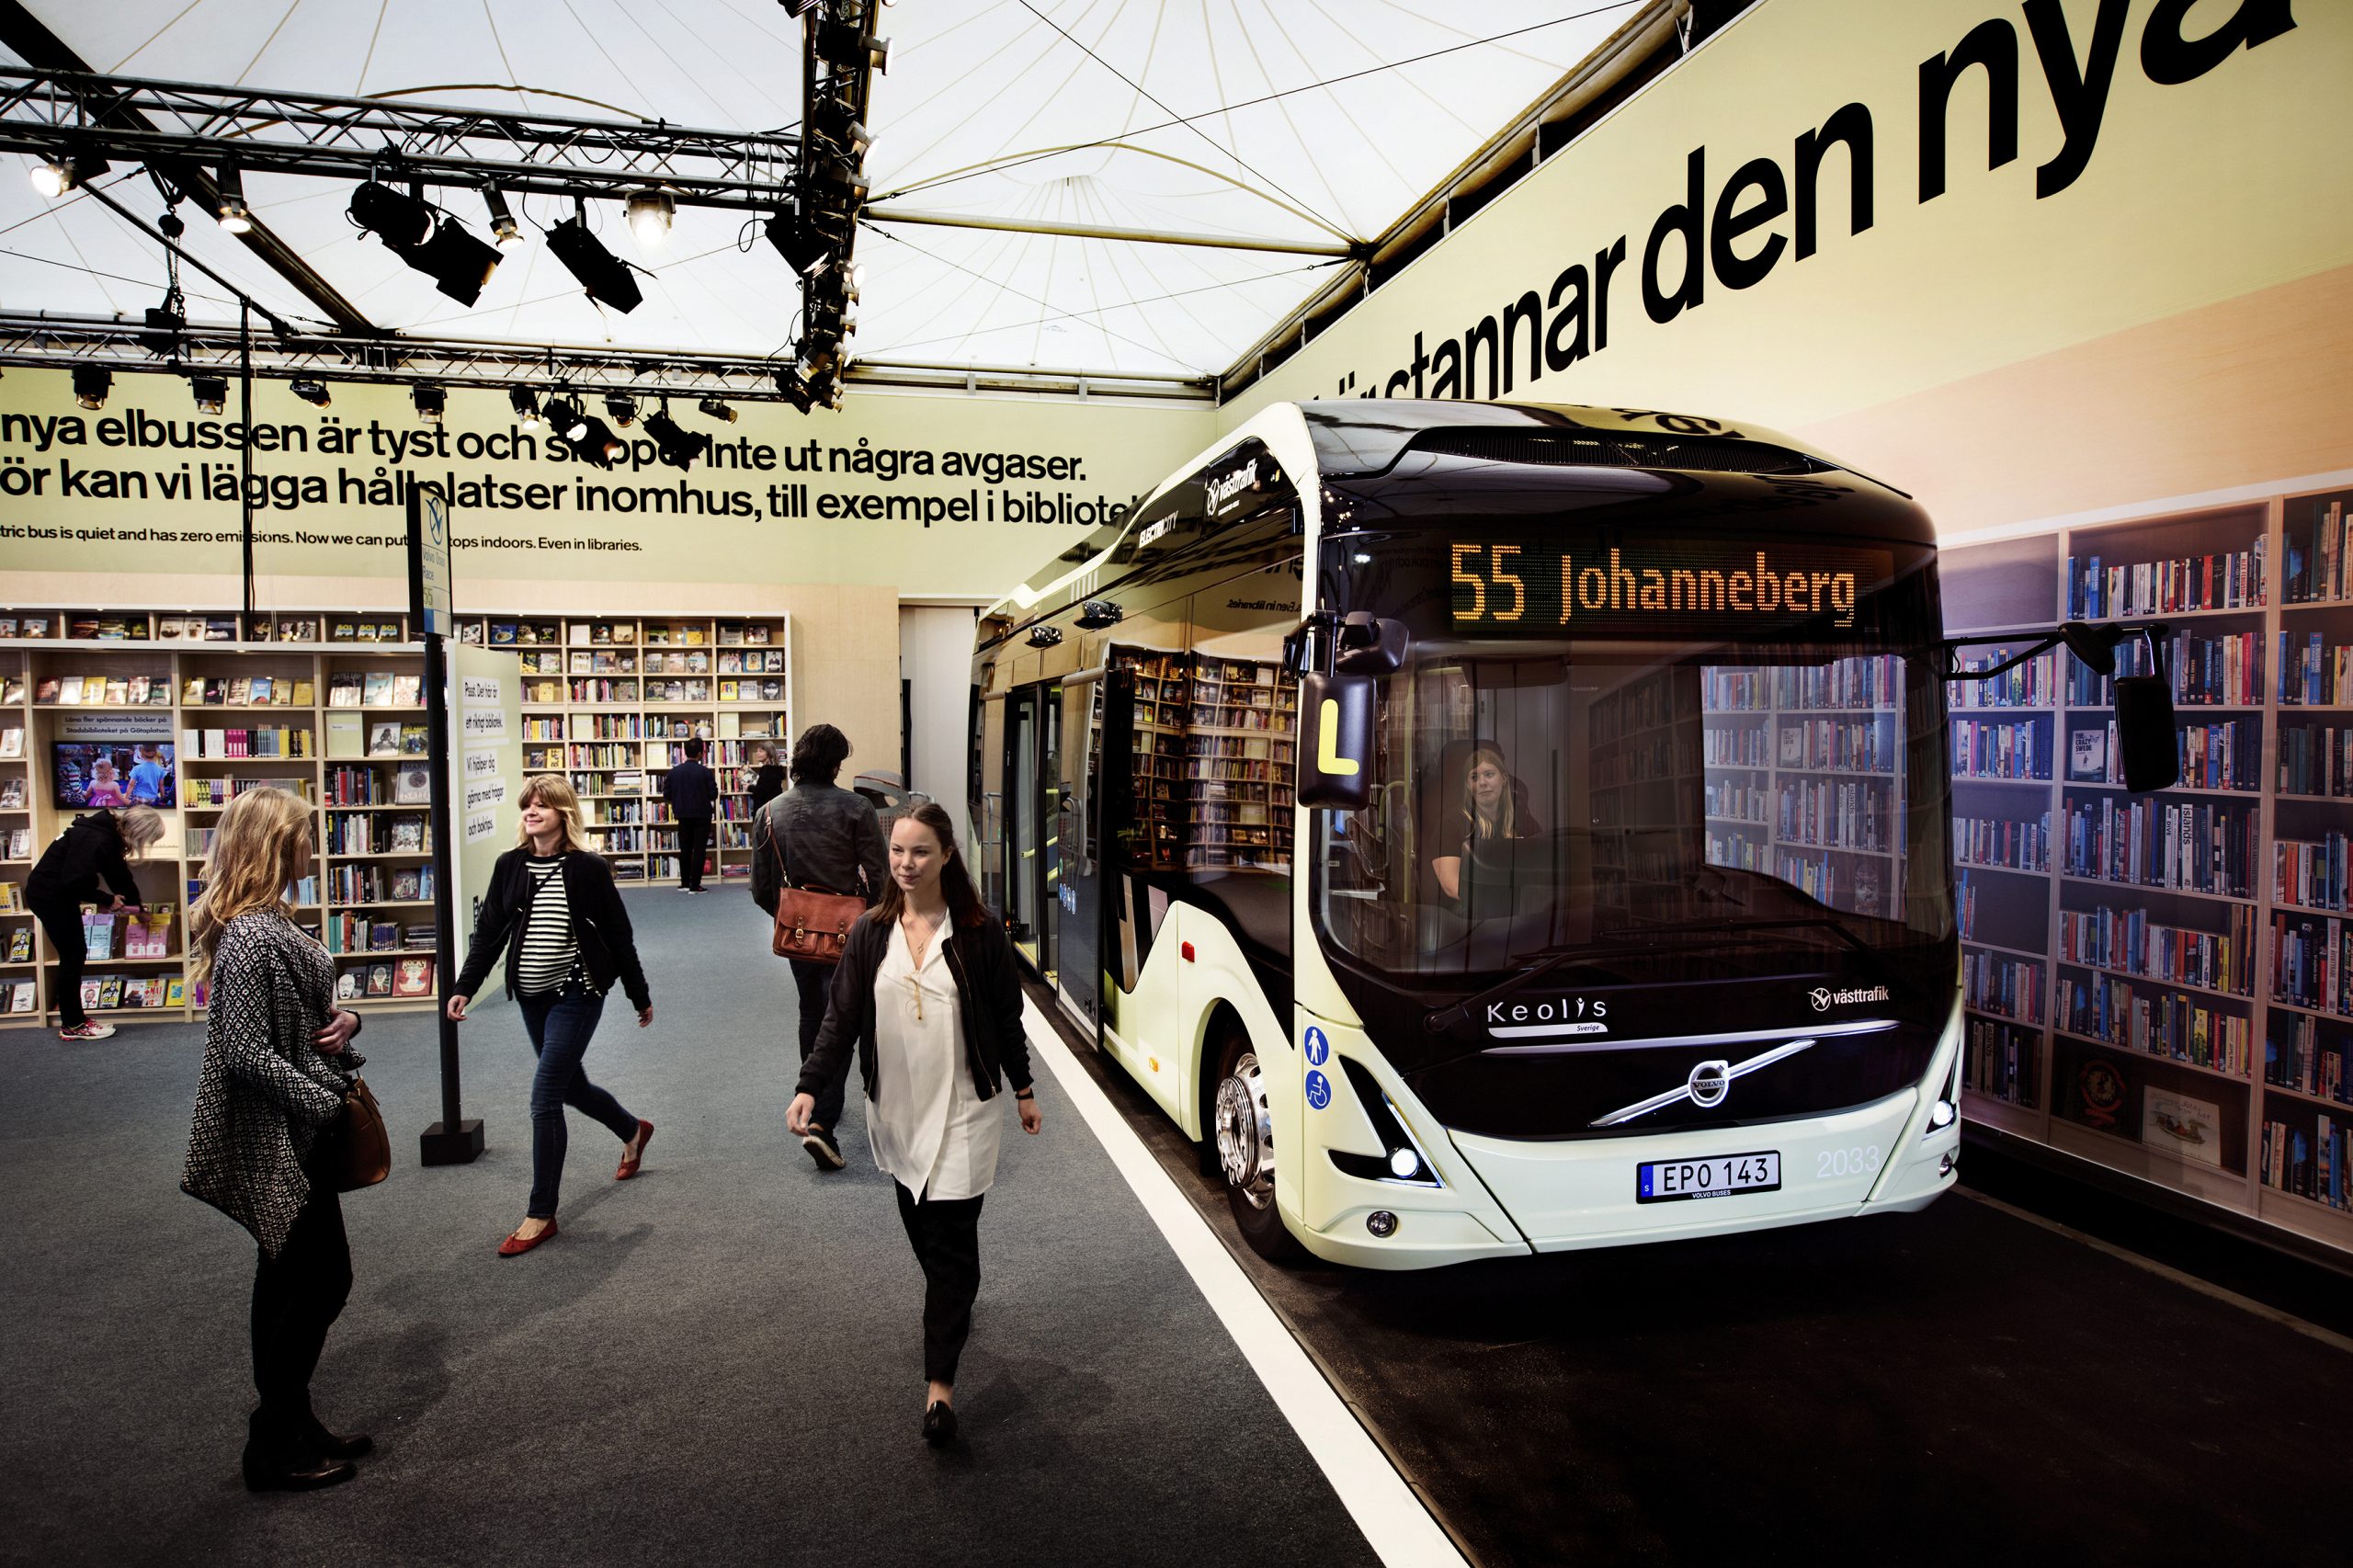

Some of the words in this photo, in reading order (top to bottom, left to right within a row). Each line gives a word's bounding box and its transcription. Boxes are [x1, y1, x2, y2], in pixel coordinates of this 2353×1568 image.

[1642, 101, 1874, 324] den
[1, 413, 87, 452] nya
[97, 408, 308, 452] elbussen
[317, 415, 362, 455] är
[368, 420, 450, 464] tyst
[457, 425, 537, 460] och
[784, 438, 822, 472] ut
[829, 437, 935, 482] några
[941, 449, 1086, 484] avgaser.
[60, 458, 148, 499] kan
[155, 462, 191, 500] vi
[200, 462, 327, 510] lägga
[575, 475, 763, 523] inomhus,
[767, 483, 808, 517] till
[816, 489, 978, 528] exempel
[987, 490, 994, 522] i
[1003, 490, 1137, 526] bibliote
[28, 525, 58, 539] bus
[60, 526, 74, 540] is
[76, 527, 116, 541] quiet
[118, 528, 147, 541] and
[150, 528, 178, 542] has
[180, 531, 213, 542] zero
[215, 529, 293, 544] emisions.
[296, 531, 329, 545] Now
[332, 534, 353, 545] we
[356, 535, 382, 546] can
[385, 533, 409, 550] put
[481, 535, 536, 550] indoors.
[538, 537, 572, 550] Even
[574, 538, 585, 550] in
[587, 539, 642, 552] libraries.
[1450, 543, 1525, 621] 55
[1559, 547, 1855, 628] Johanneberg
[2183, 806, 2193, 845] islands
[403, 959, 426, 971] ROCKY
[1486, 996, 1607, 1022] Keolis
[1833, 985, 1890, 1005] västtrafik
[1576, 1023, 1600, 1033] Sverige
[1691, 1079, 1725, 1089] VOLVO
[1643, 1184, 1650, 1192] S
[1664, 1164, 1711, 1192] EPO
[1723, 1157, 1768, 1186] 143
[1816, 1145, 1880, 1179] 2033
[1711, 1189, 1731, 1198] BUSES
